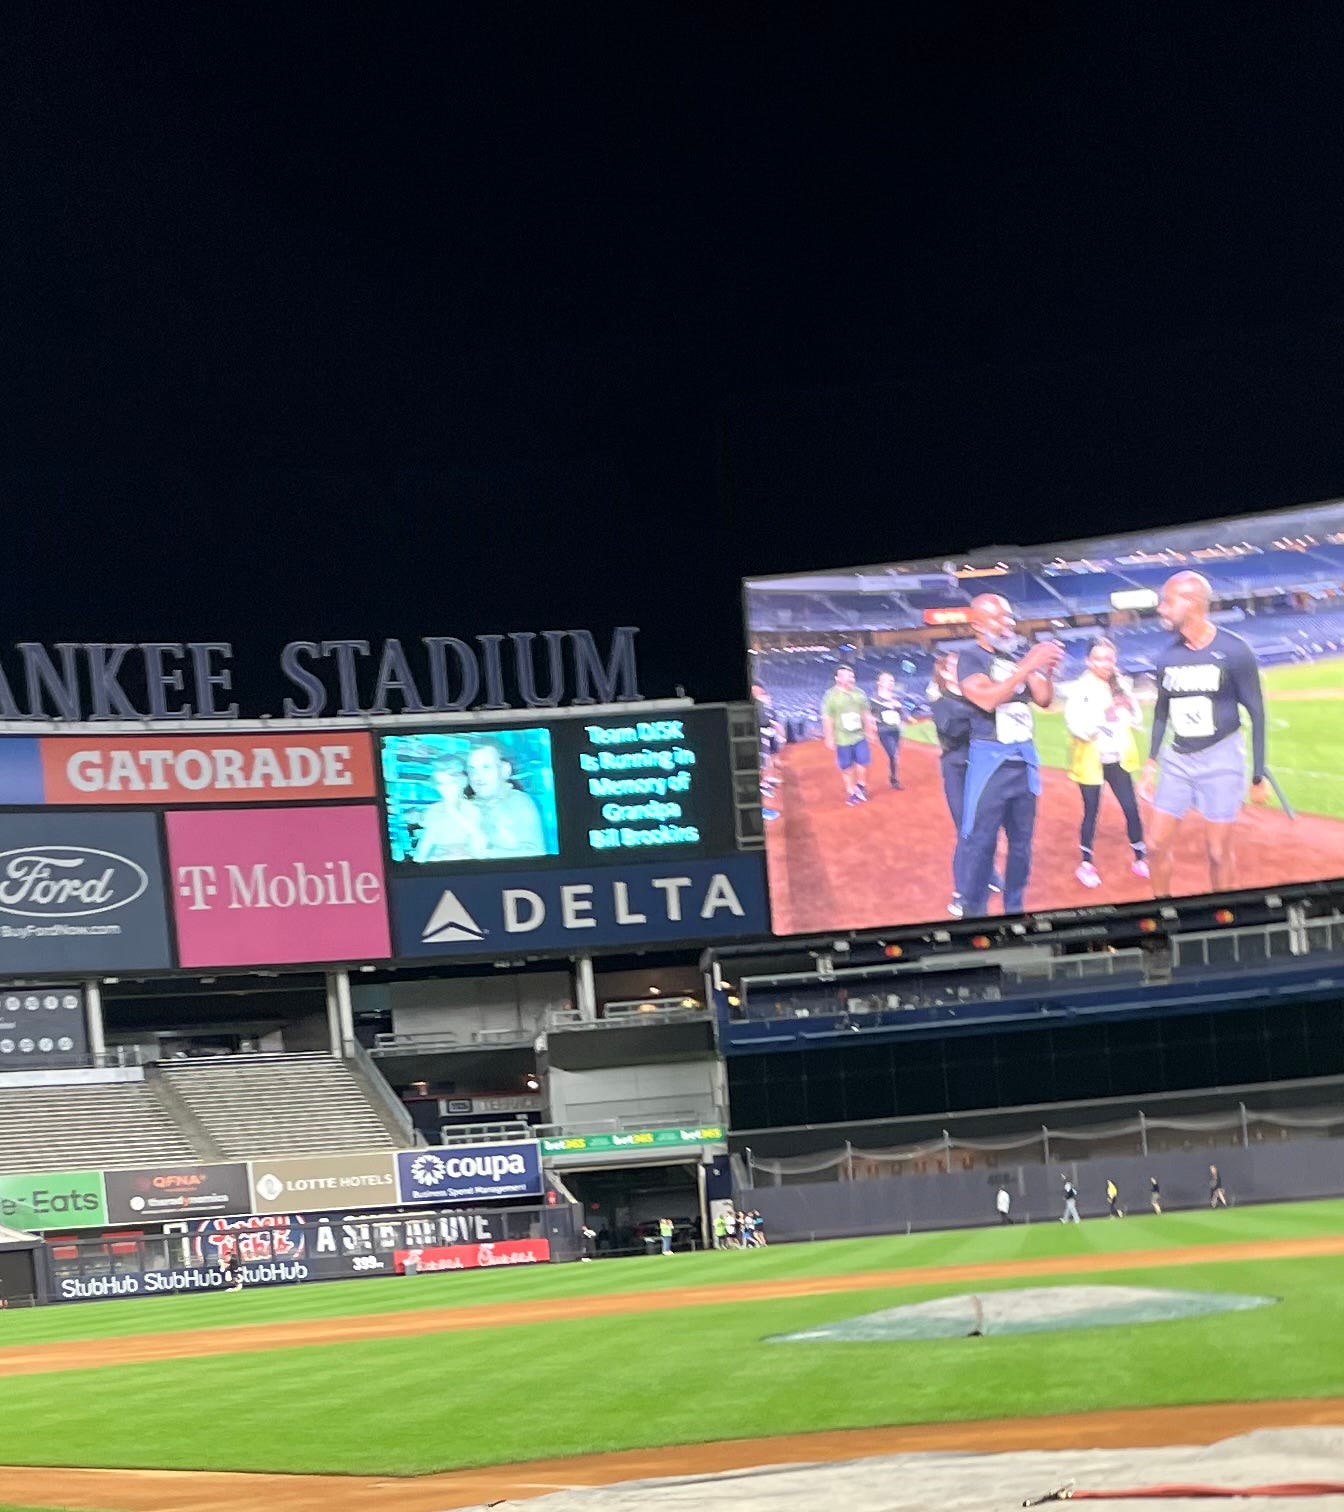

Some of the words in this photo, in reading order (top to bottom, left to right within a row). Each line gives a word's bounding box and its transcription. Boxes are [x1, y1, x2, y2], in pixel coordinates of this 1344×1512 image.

[280, 626, 645, 718] STADIUM
[65, 746, 352, 792] GATORADE
[229, 860, 382, 909] Mobile
[502, 873, 746, 933] DELTA
[287, 1177, 337, 1192] LOTTE
[340, 1174, 393, 1188] HOTELS
[446, 1154, 525, 1182] coupa
[33, 1190, 98, 1214] Eats
[62, 1275, 138, 1298] StubHub
[144, 1270, 222, 1292] StubHub
